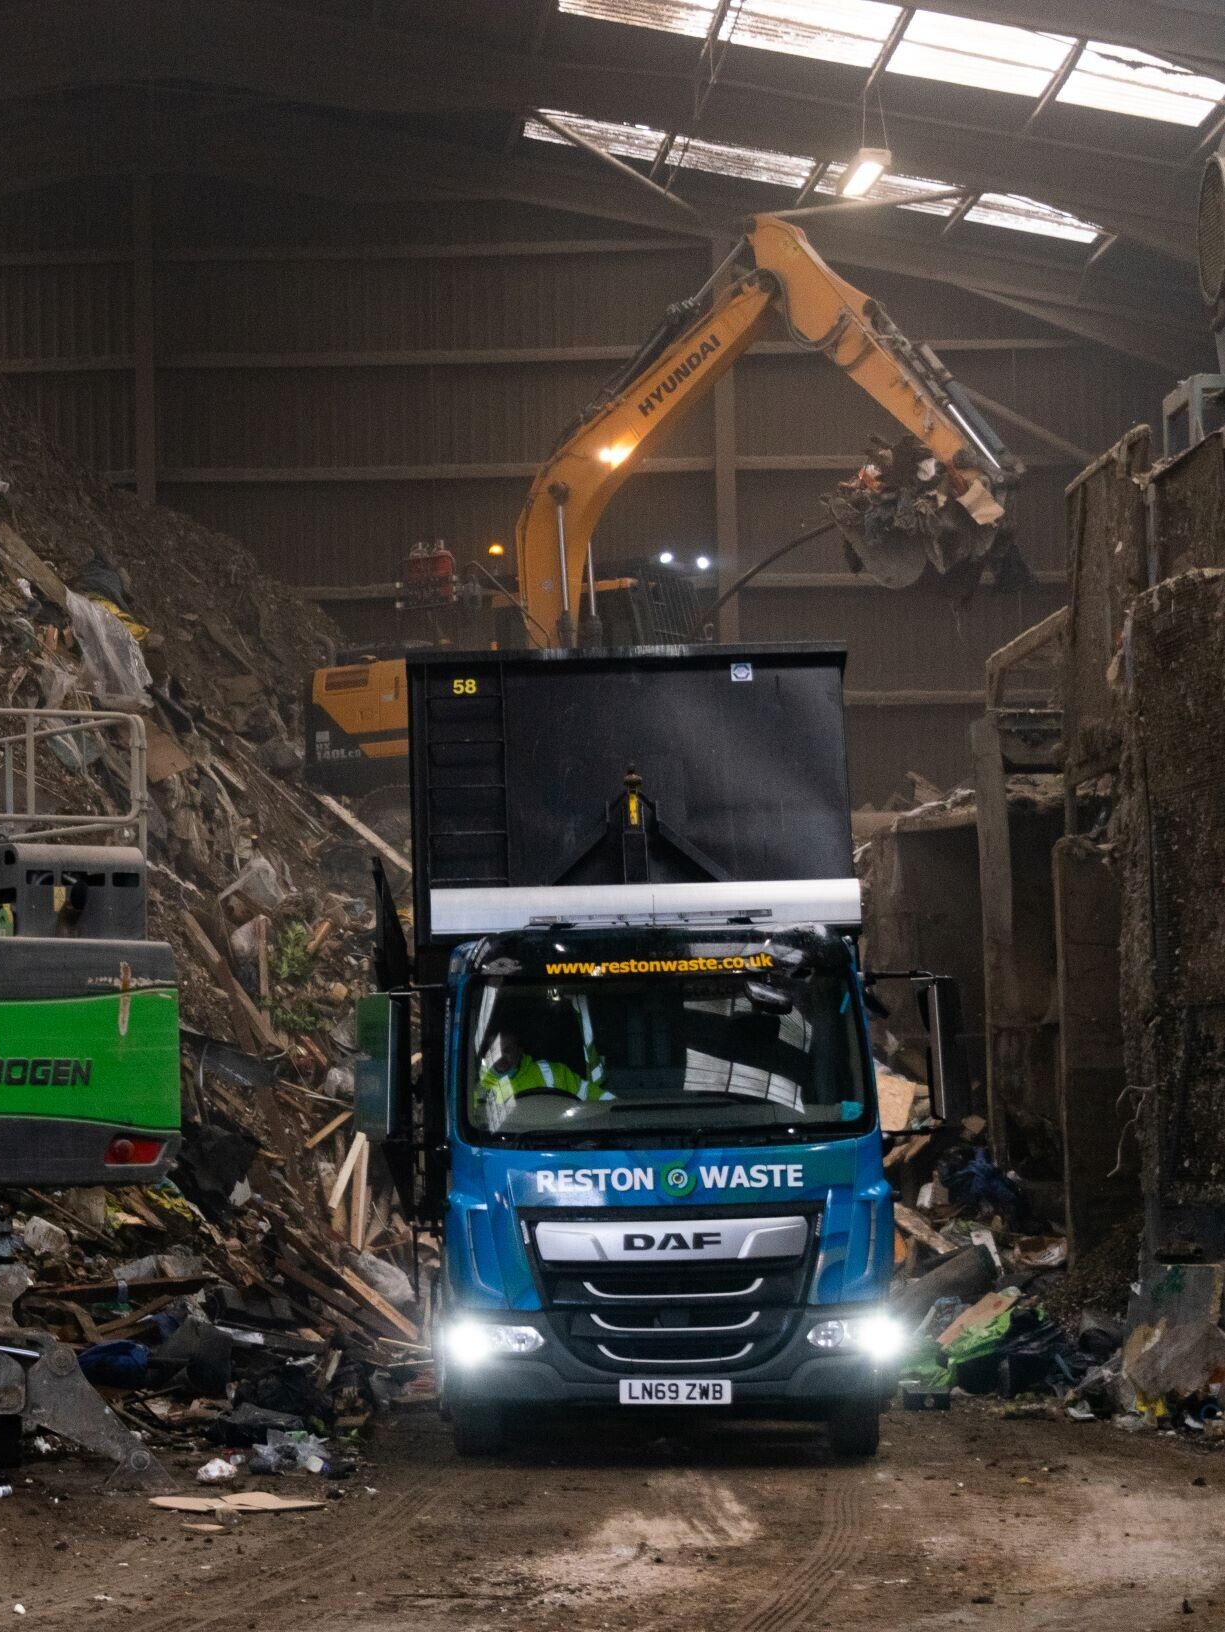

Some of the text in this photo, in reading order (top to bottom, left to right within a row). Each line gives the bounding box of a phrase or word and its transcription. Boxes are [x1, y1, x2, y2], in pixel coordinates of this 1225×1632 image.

[637, 334, 721, 418] HYUNDAI
[452, 678, 477, 695] 58
[545, 952, 773, 976] www.restonwaste.co.uk
[536, 1163, 804, 1194] RESTON WASTE
[623, 1231, 722, 1251] DAF
[628, 1382, 723, 1401] LN69 ZWB
